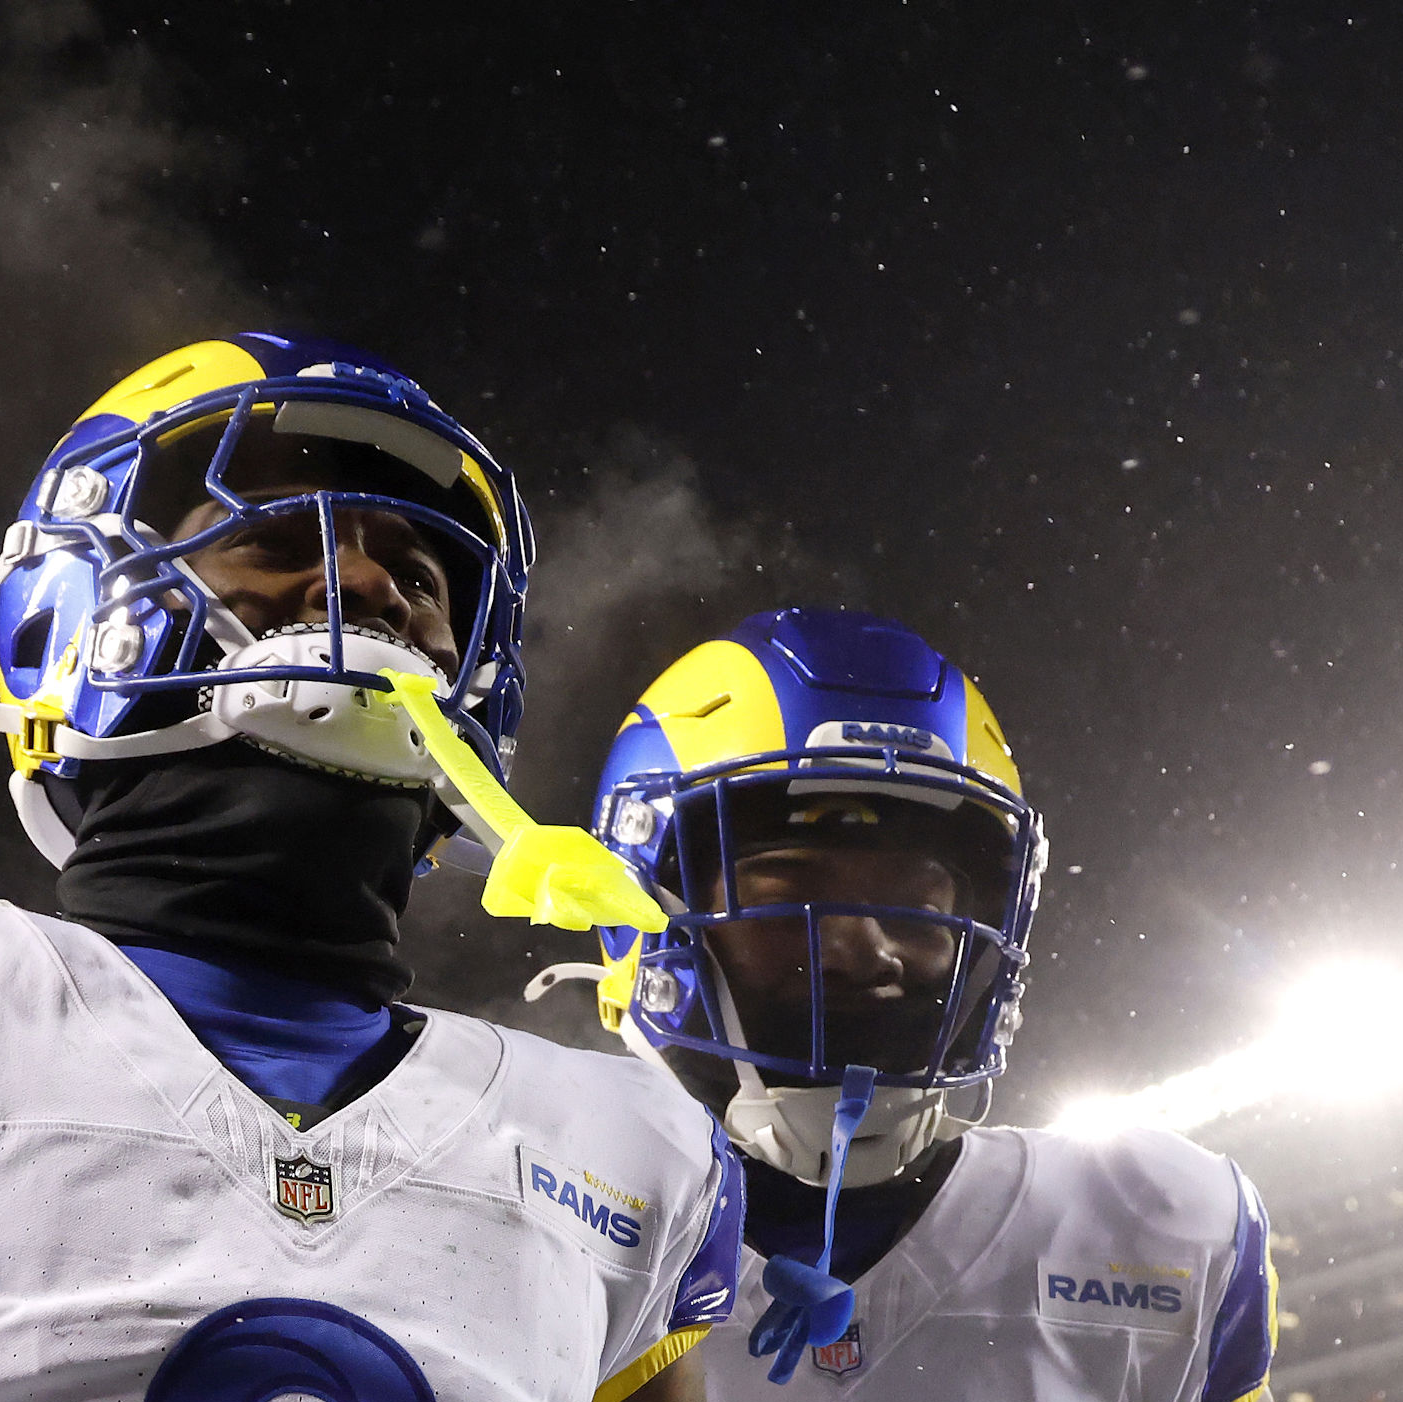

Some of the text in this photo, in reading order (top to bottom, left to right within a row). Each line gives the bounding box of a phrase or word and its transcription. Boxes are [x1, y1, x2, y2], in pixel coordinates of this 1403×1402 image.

[841, 722, 935, 750] RAMS
[282, 1180, 328, 1211] NFL
[530, 1162, 641, 1248] RAMS
[1048, 1274, 1182, 1313] RAMS
[819, 1342, 859, 1368] NFL
